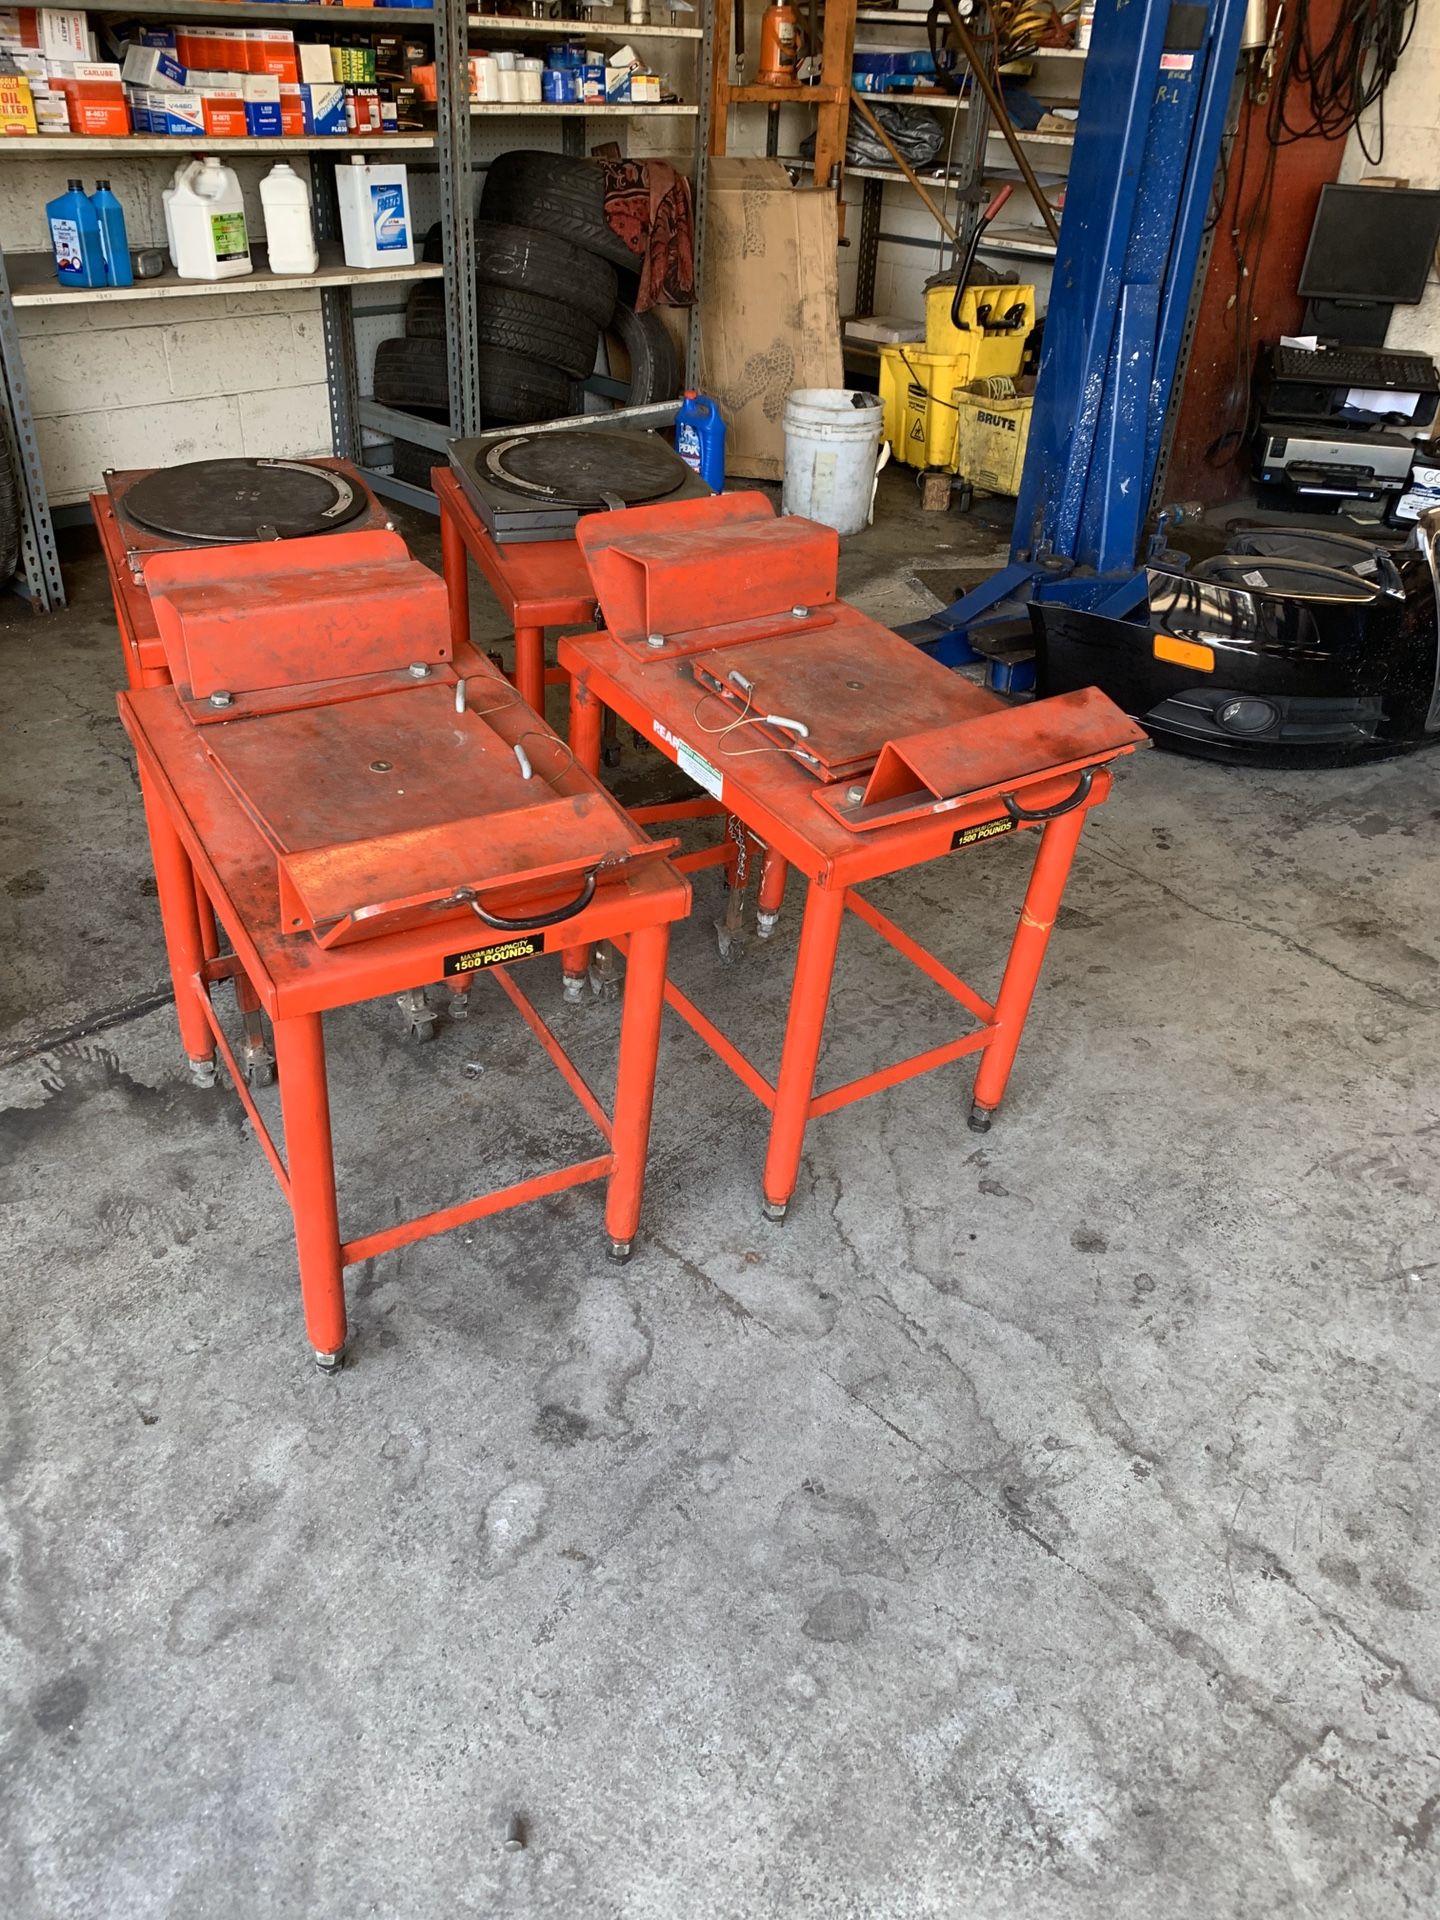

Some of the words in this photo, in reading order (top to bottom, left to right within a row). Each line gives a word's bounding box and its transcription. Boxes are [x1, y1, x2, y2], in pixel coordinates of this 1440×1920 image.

[83, 69, 114, 77] CARLUBE
[1, 92, 21, 104] OIL
[976, 410, 1016, 433] BRUTE
[679, 443, 700, 457] PEAK
[653, 719, 679, 751] REAR
[958, 833, 977, 845] 1500
[977, 822, 1013, 839] POUNDS
[454, 958, 481, 971] 1500
[484, 944, 534, 964] POUNDS
[460, 948, 494, 962] MAXIMUM
[494, 939, 529, 954] CAPACITY
